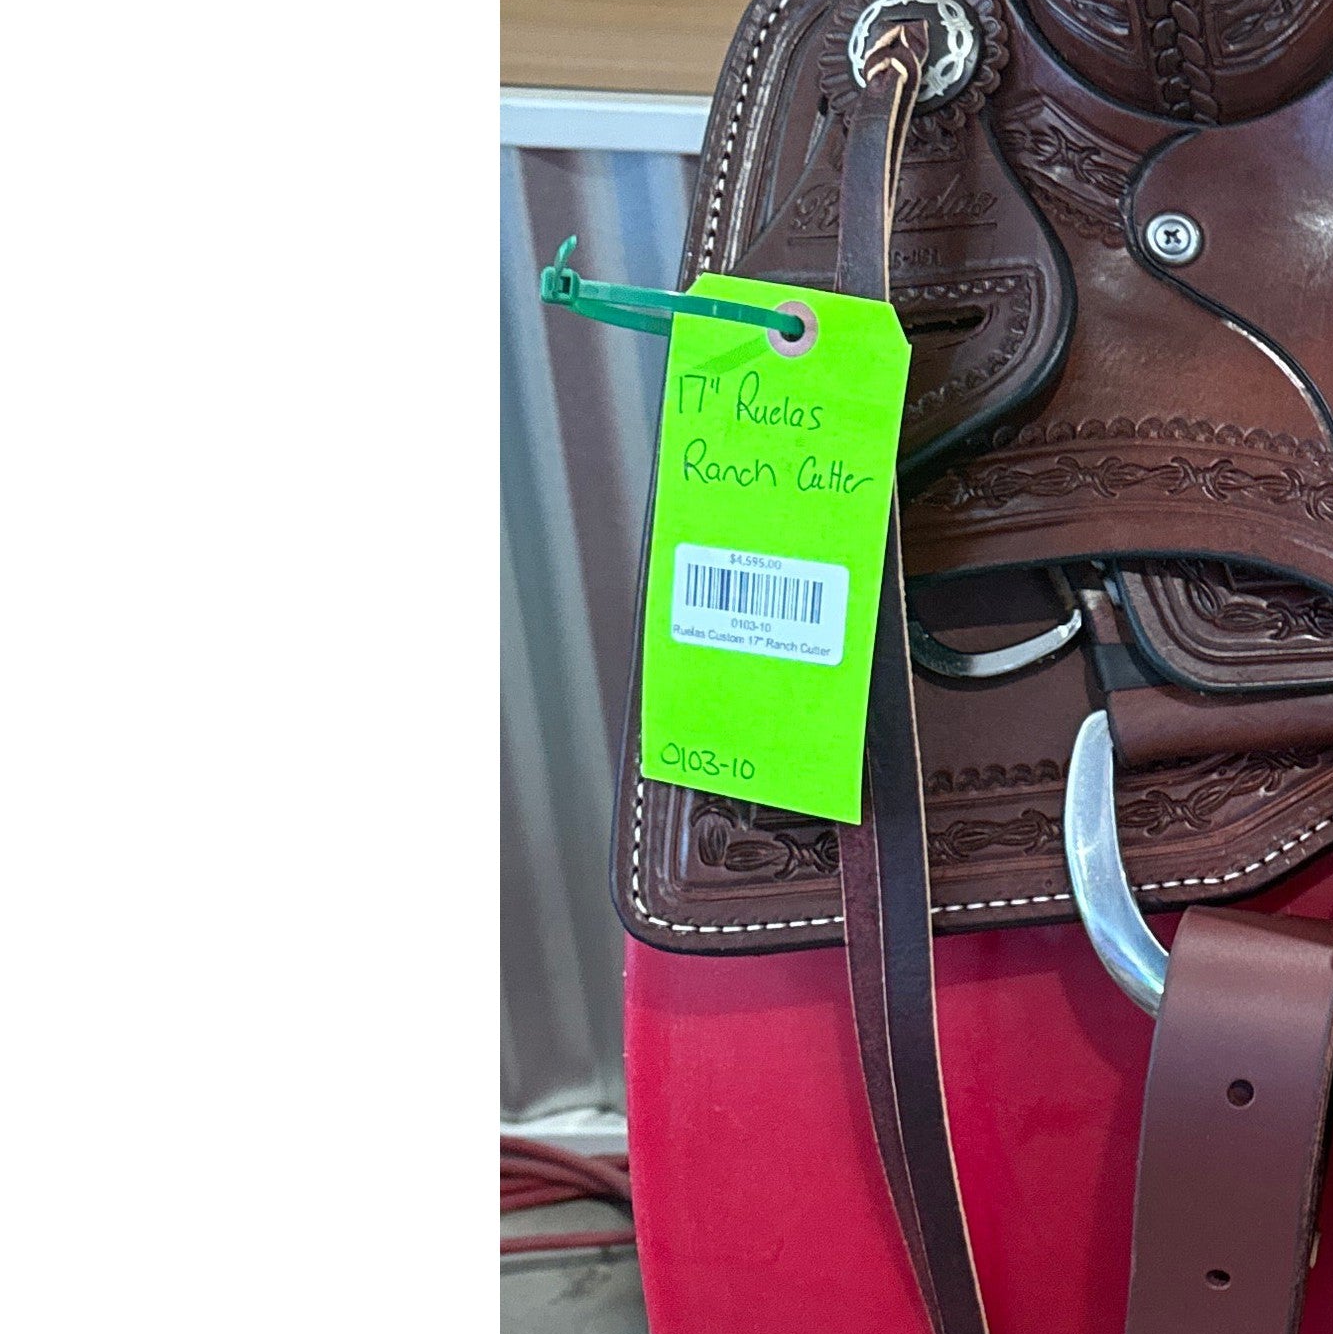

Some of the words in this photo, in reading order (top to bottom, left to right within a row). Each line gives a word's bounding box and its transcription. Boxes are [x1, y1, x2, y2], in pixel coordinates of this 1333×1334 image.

[678, 373, 721, 415] 17"
[736, 370, 824, 431] Ruelas
[683, 438, 777, 488] Ranch
[797, 455, 875, 495] Cutter
[673, 624, 706, 639] Ruelas
[708, 629, 745, 644] Custom
[766, 638, 798, 653] Ranch
[800, 643, 832, 657] Cutter
[731, 618, 772, 633] 0103-10
[660, 742, 756, 780] 0103-10
